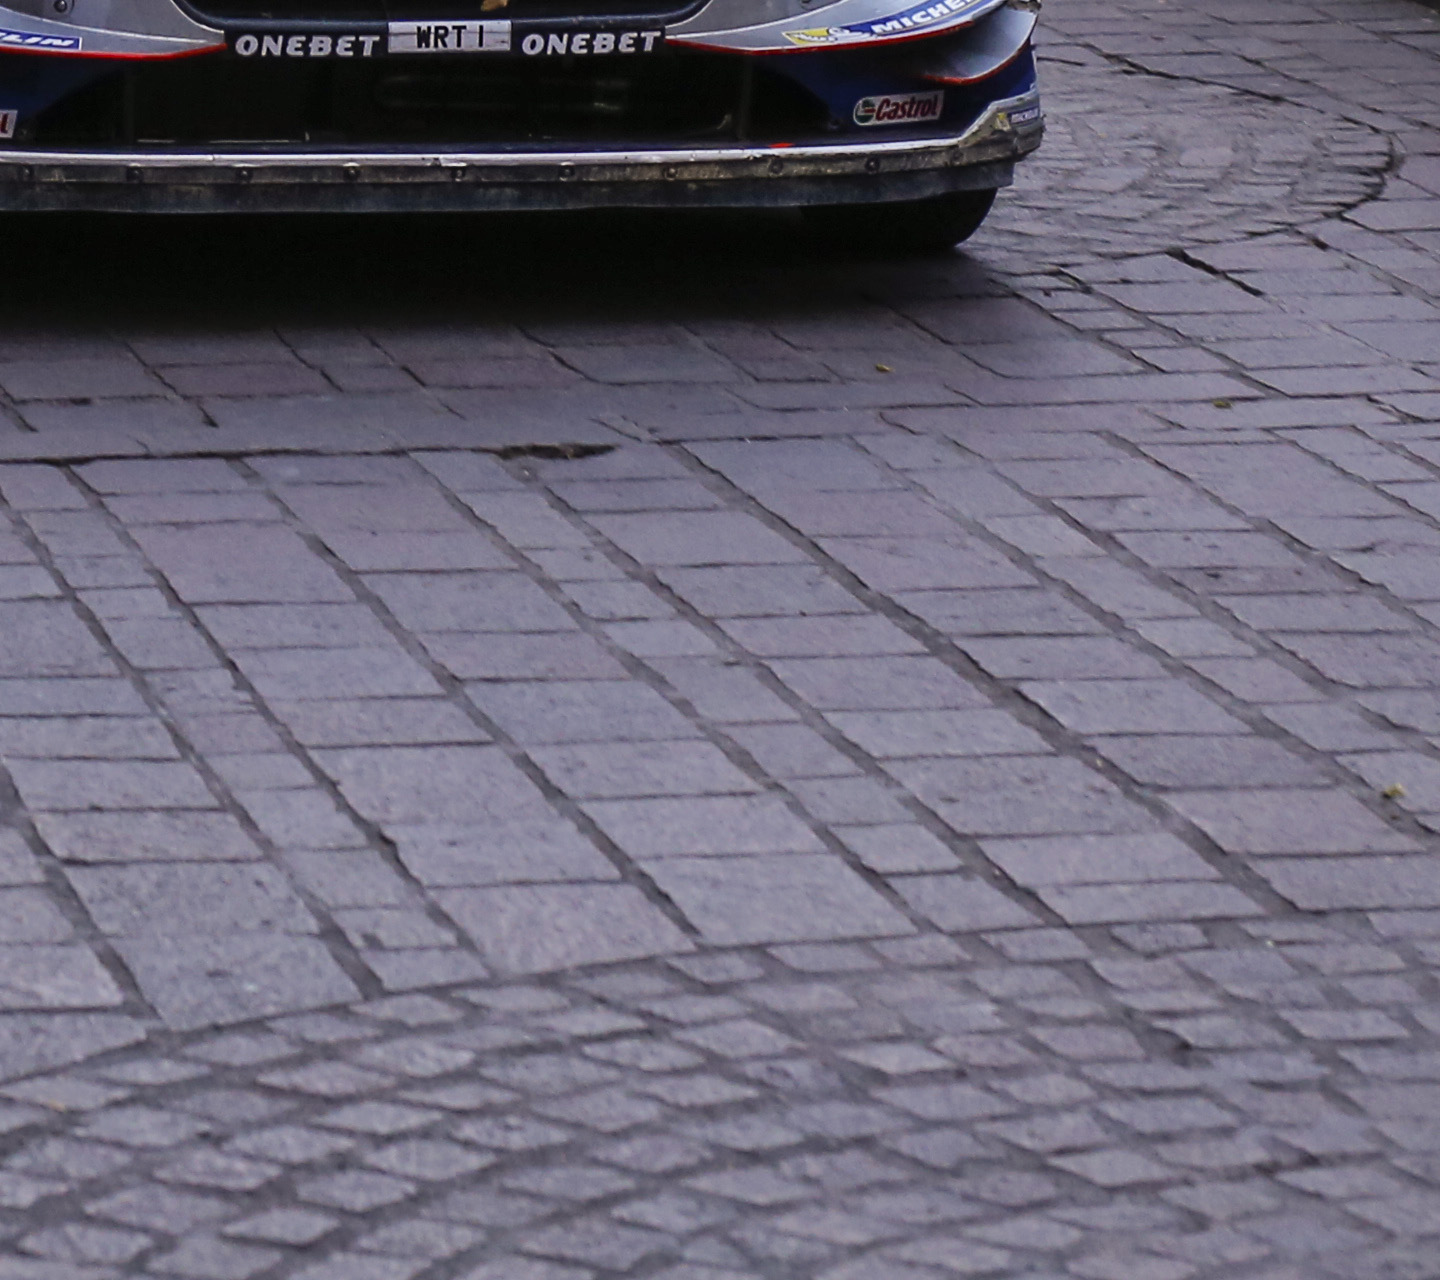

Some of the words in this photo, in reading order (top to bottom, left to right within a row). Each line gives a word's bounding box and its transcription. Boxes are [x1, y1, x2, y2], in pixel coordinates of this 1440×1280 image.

[235, 34, 381, 57] ONEBET
[416, 25, 466, 49] WRT
[522, 31, 661, 55] ONEBET
[874, 96, 940, 121] Castrol
